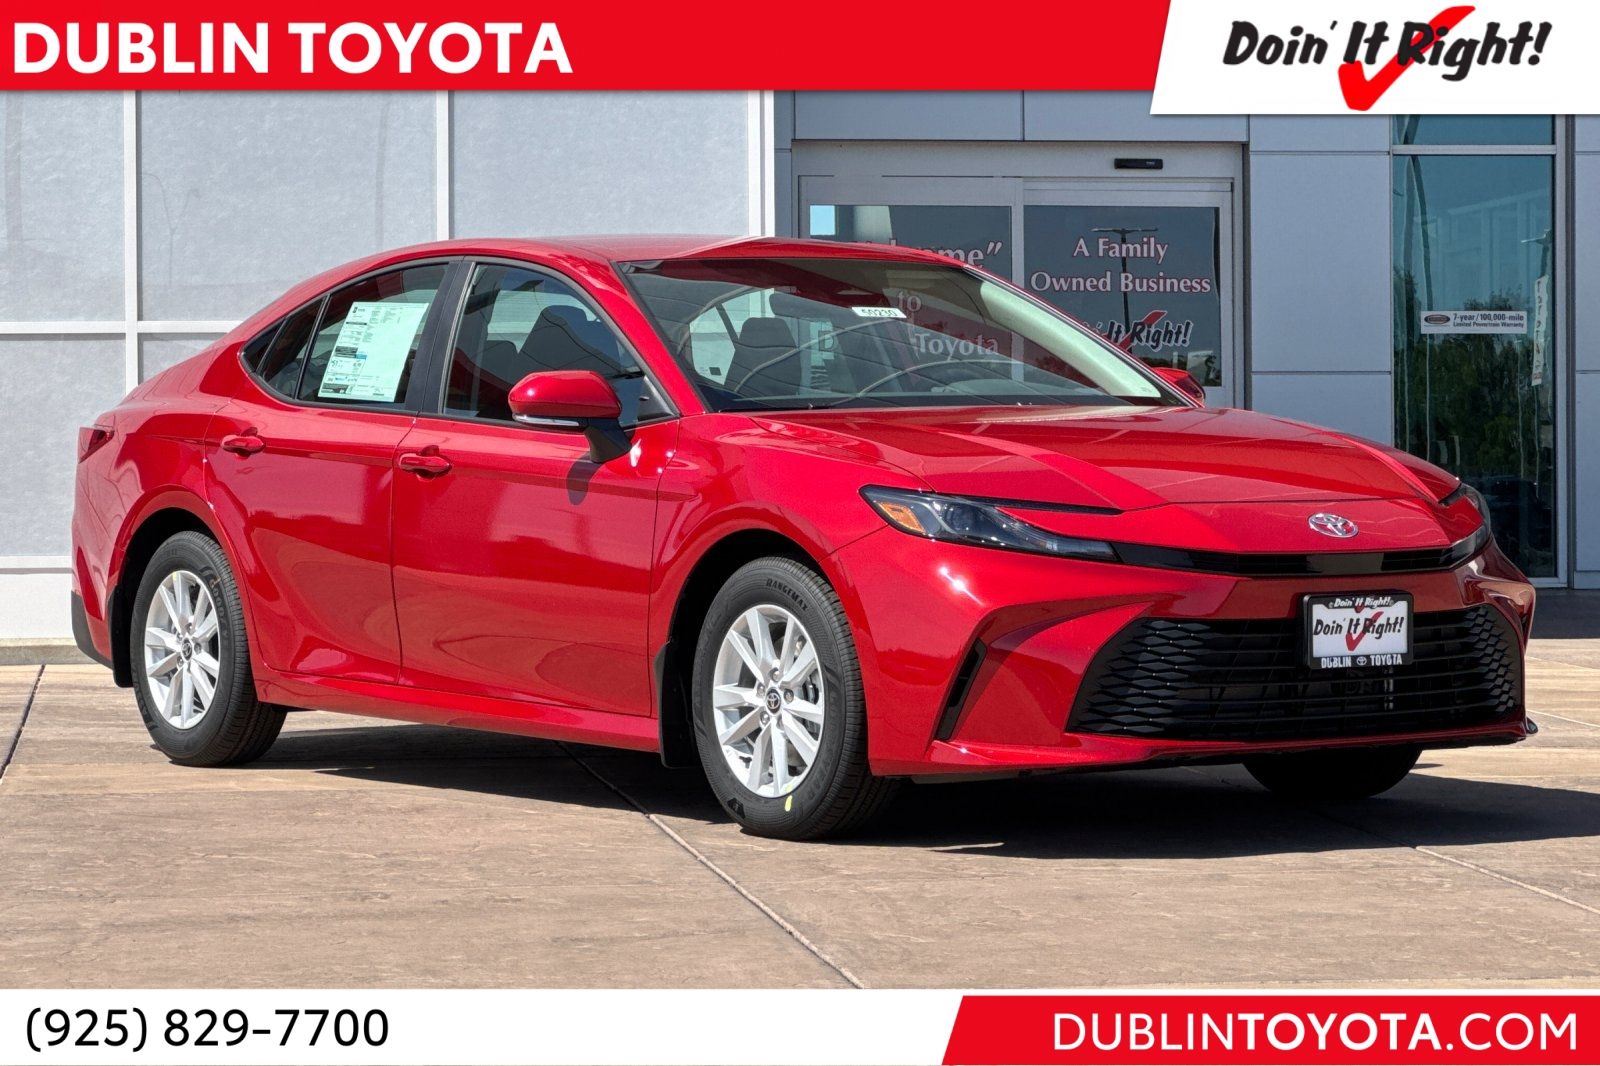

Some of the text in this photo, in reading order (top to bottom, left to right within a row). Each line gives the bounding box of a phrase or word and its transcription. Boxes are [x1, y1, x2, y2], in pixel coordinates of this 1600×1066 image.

[1073, 237, 1168, 264] A Family
[1030, 271, 1211, 293] Owned Business
[1130, 319, 1193, 351] Right!
[916, 334, 999, 361] Toyota
[1313, 617, 1405, 639] Doin' It Right!
[1321, 654, 1402, 668] DUBLIN TOYOTA
